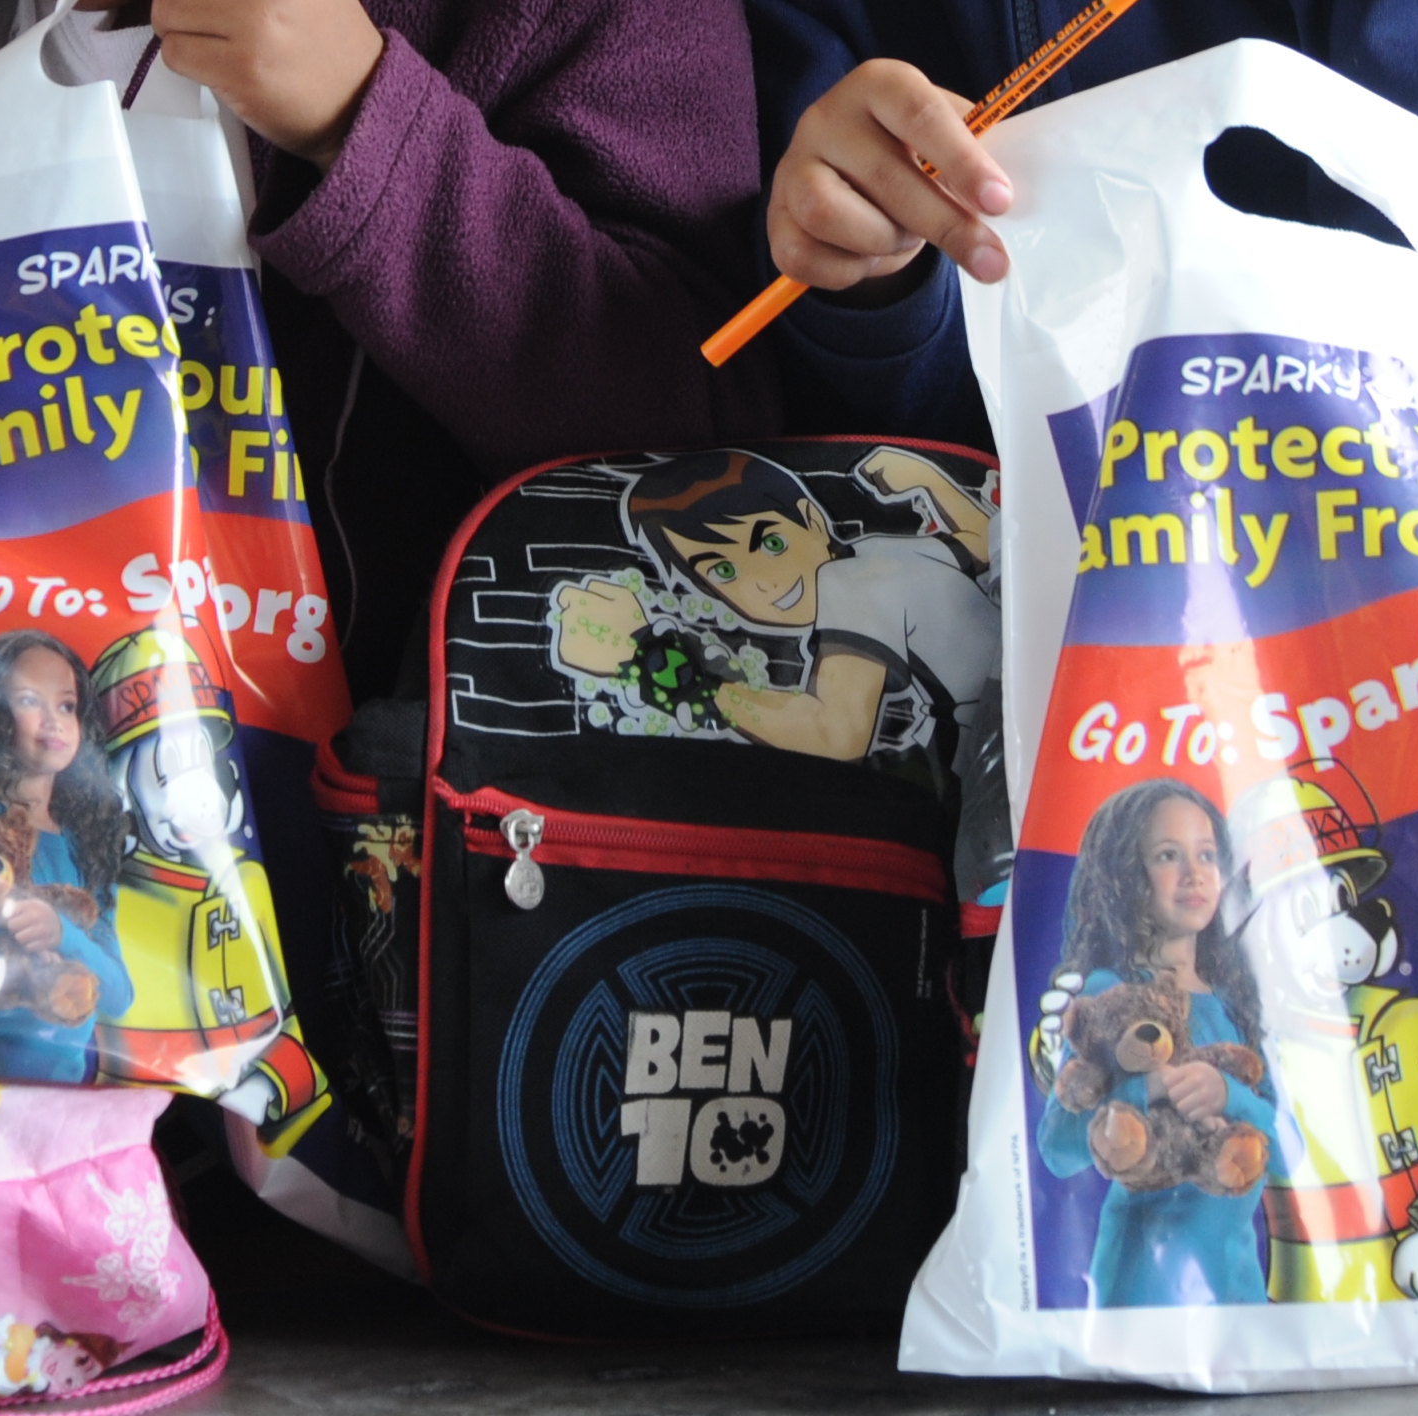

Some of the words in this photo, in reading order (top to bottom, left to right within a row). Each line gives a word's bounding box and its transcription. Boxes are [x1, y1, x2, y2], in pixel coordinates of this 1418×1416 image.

[1099, 415, 1400, 489] Protect
[1077, 487, 1290, 589] amily
[625, 1010, 793, 1096] BEN
[619, 1097, 787, 1188] 10
